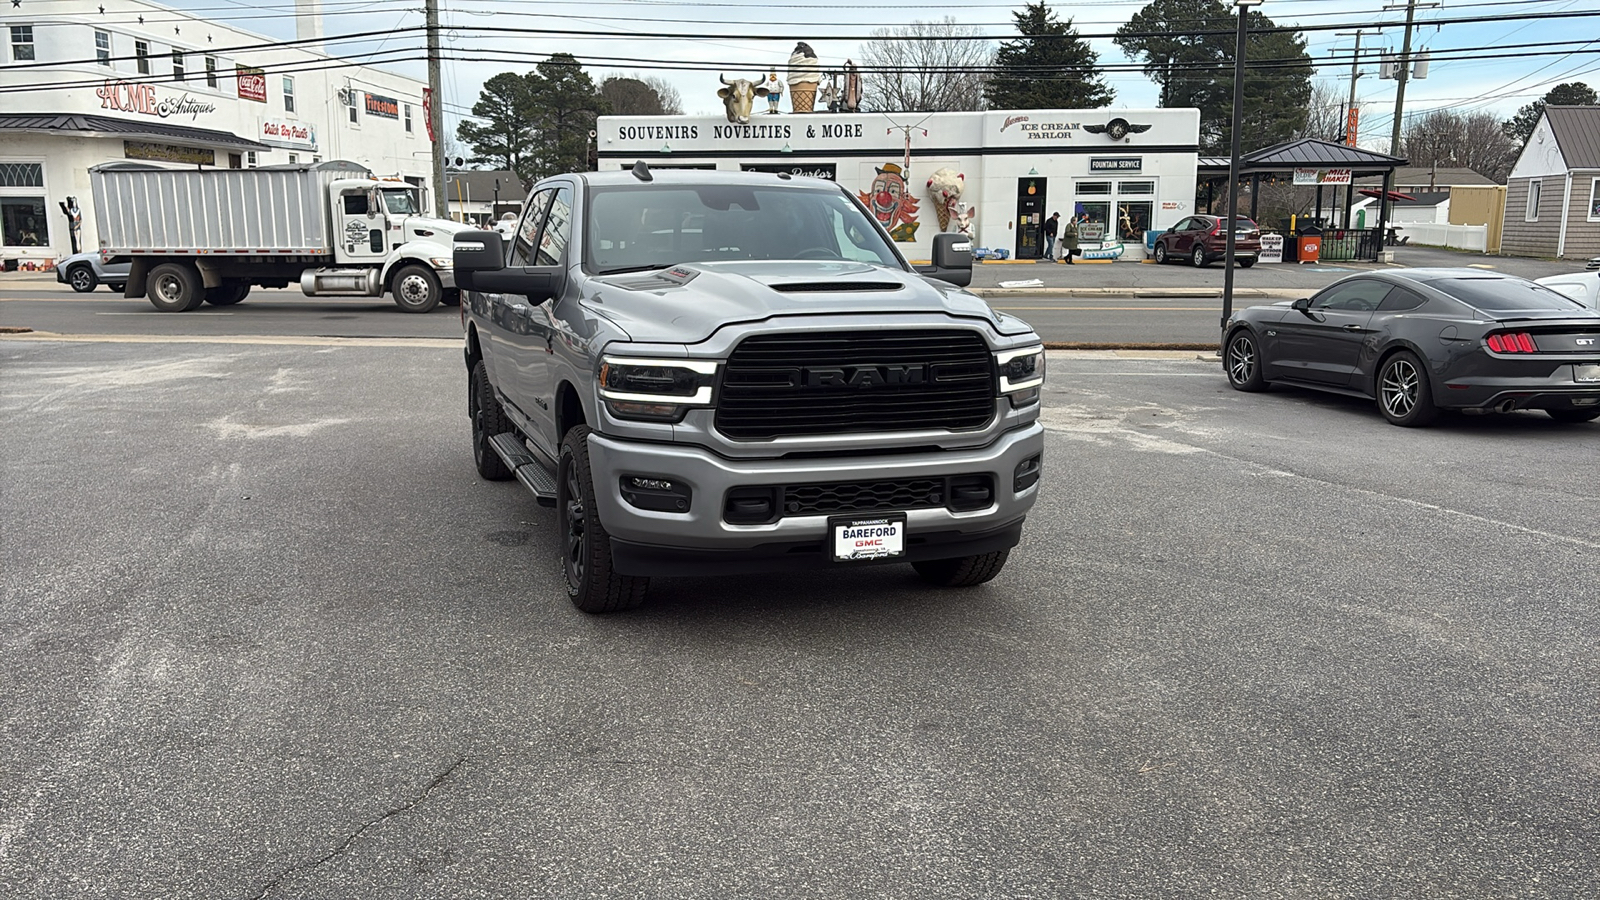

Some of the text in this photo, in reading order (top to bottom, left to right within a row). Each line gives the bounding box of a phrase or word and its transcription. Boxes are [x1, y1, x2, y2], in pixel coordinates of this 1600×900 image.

[96, 78, 158, 115] ACME
[171, 93, 216, 121] Antiques
[365, 94, 398, 114] Firestone
[264, 122, 308, 140] Dutch Boy Paints
[619, 124, 863, 140] SOUVENIRS NOVELTIES & MORE
[1021, 122, 1080, 131] ICE CREAM
[1092, 160, 1140, 168] FOUNTAIN SERVICE
[807, 365, 924, 388] RAM
[843, 527, 897, 539] BAREFORD
[855, 539, 883, 547] GMC
